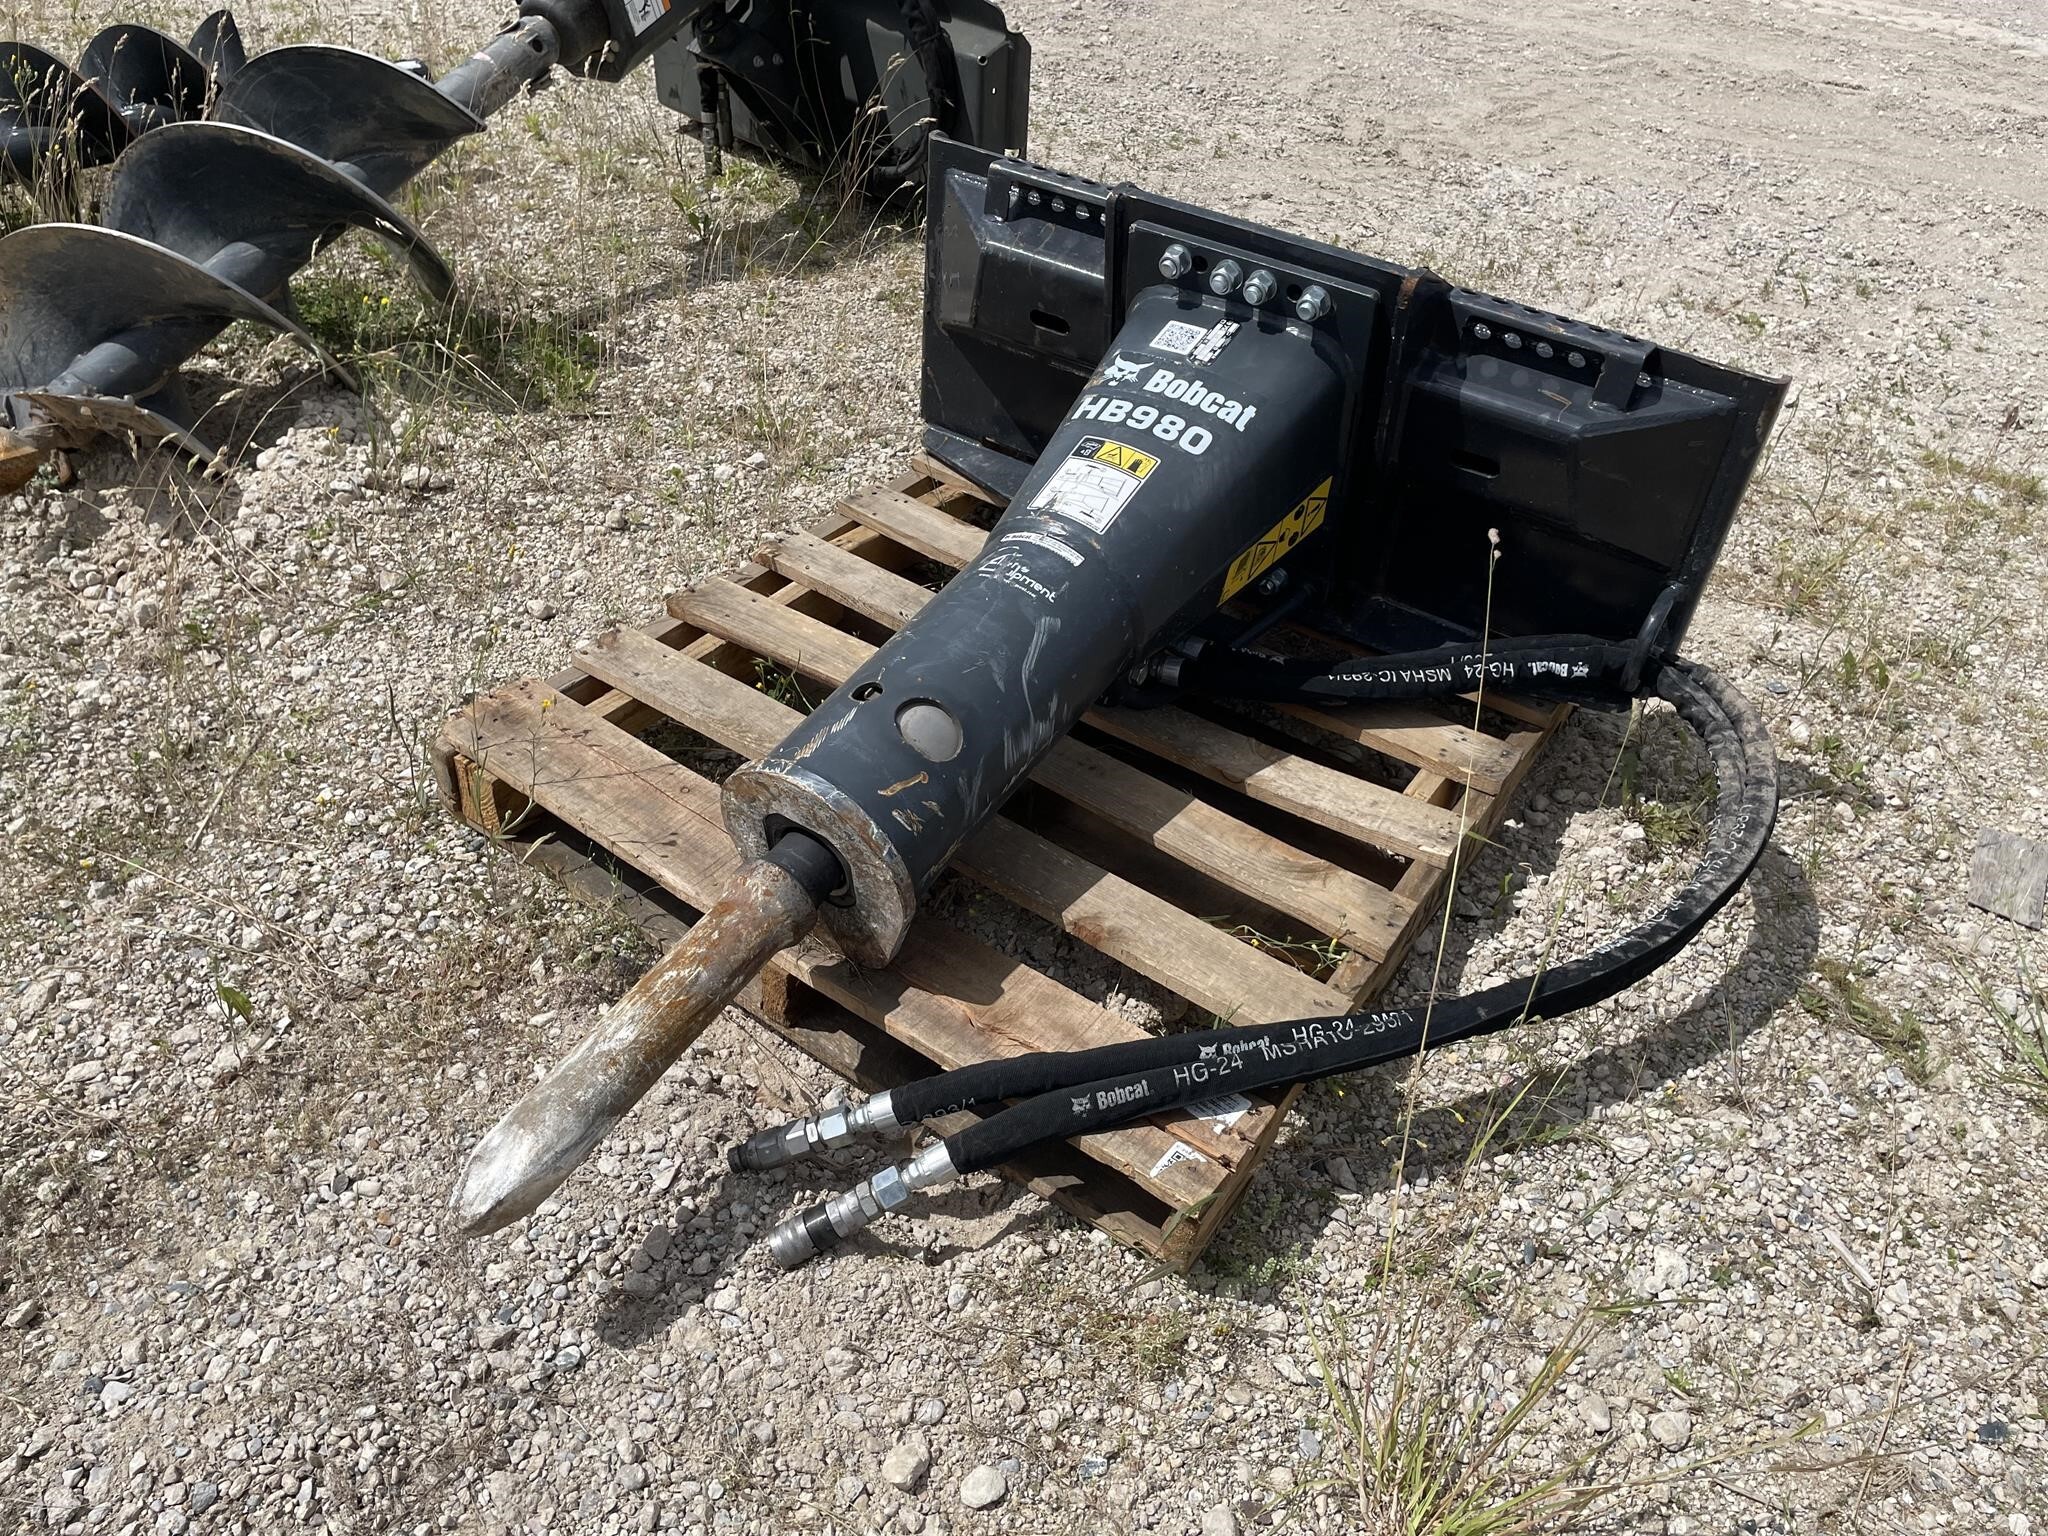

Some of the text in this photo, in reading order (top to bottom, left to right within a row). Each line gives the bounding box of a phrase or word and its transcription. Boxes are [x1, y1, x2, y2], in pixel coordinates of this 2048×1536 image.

[1071, 396, 1213, 456] HB980
[1143, 369, 1257, 433] Bobcat
[1402, 666, 1451, 683] MSHA
[1464, 661, 1514, 678] HG-24
[1096, 1079, 1150, 1111] Bobcat
[1173, 1053, 1244, 1088] HG-24
